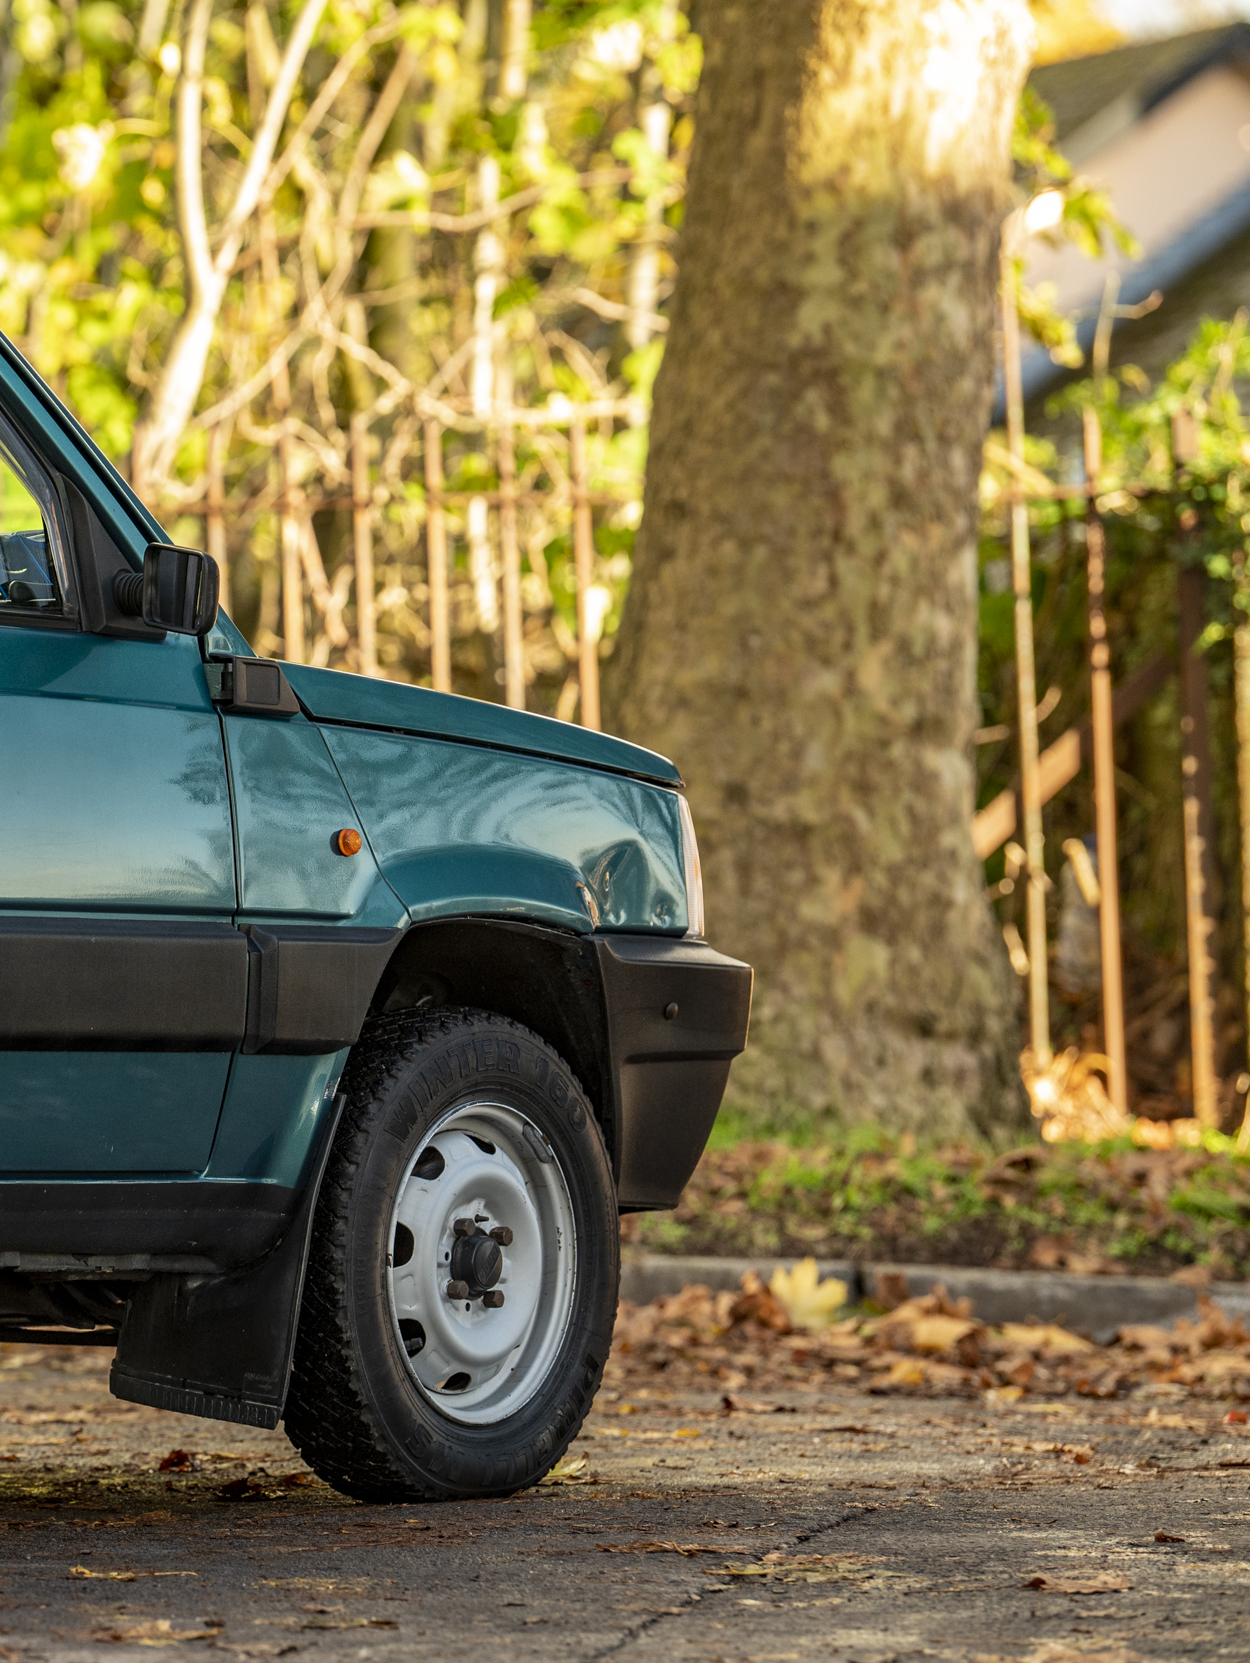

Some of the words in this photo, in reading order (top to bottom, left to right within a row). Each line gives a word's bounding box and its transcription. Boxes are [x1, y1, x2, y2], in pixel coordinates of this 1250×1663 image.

[382, 1037, 521, 1143] WINTER
[534, 1056, 587, 1133] 160
[479, 1352, 599, 1486] PIRELLI
